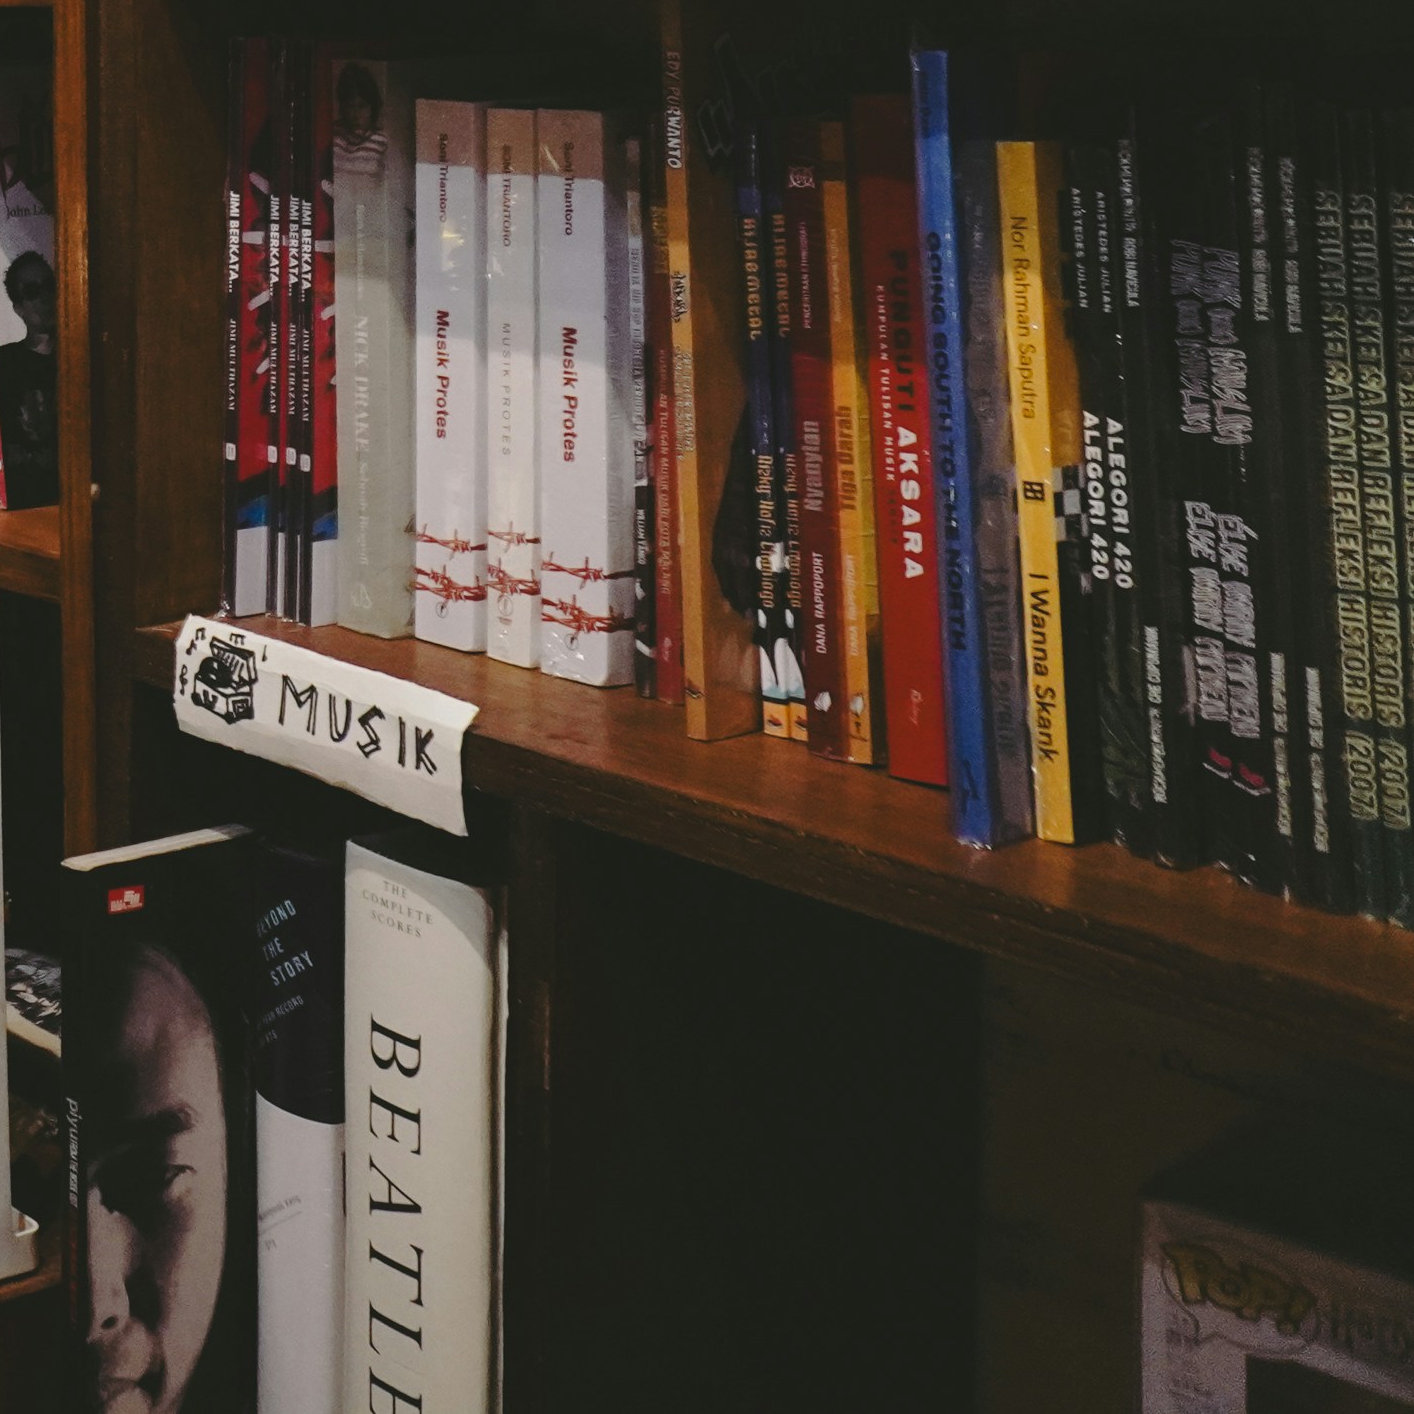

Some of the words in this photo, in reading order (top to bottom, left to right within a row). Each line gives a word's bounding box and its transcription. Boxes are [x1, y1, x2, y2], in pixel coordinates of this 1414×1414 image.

[667, 87, 682, 169] PURWANTO
[228, 191, 240, 217] JIMI
[1010, 216, 1028, 249] Nor
[1012, 258, 1031, 337] Rahman
[436, 310, 449, 369] Musik
[562, 326, 578, 388] Musik
[436, 375, 449, 438] Protes
[1016, 343, 1037, 418] Saputra
[562, 395, 578, 463] Protes
[1082, 410, 1106, 524] ALEGORI
[1106, 416, 1129, 532] ALEGORI
[898, 426, 925, 579] AKSARA
[1090, 532, 1110, 580] 420
[1114, 541, 1135, 589] 420
[1030, 590, 1050, 676] Wanna
[278, 673, 437, 777] MUSIK
[1035, 685, 1058, 764] Skank
[363, 889, 434, 925] COMPLETE
[383, 880, 408, 899] THE
[262, 937, 284, 961] THE
[371, 912, 421, 938] SCORES
[270, 951, 314, 986] STORY
